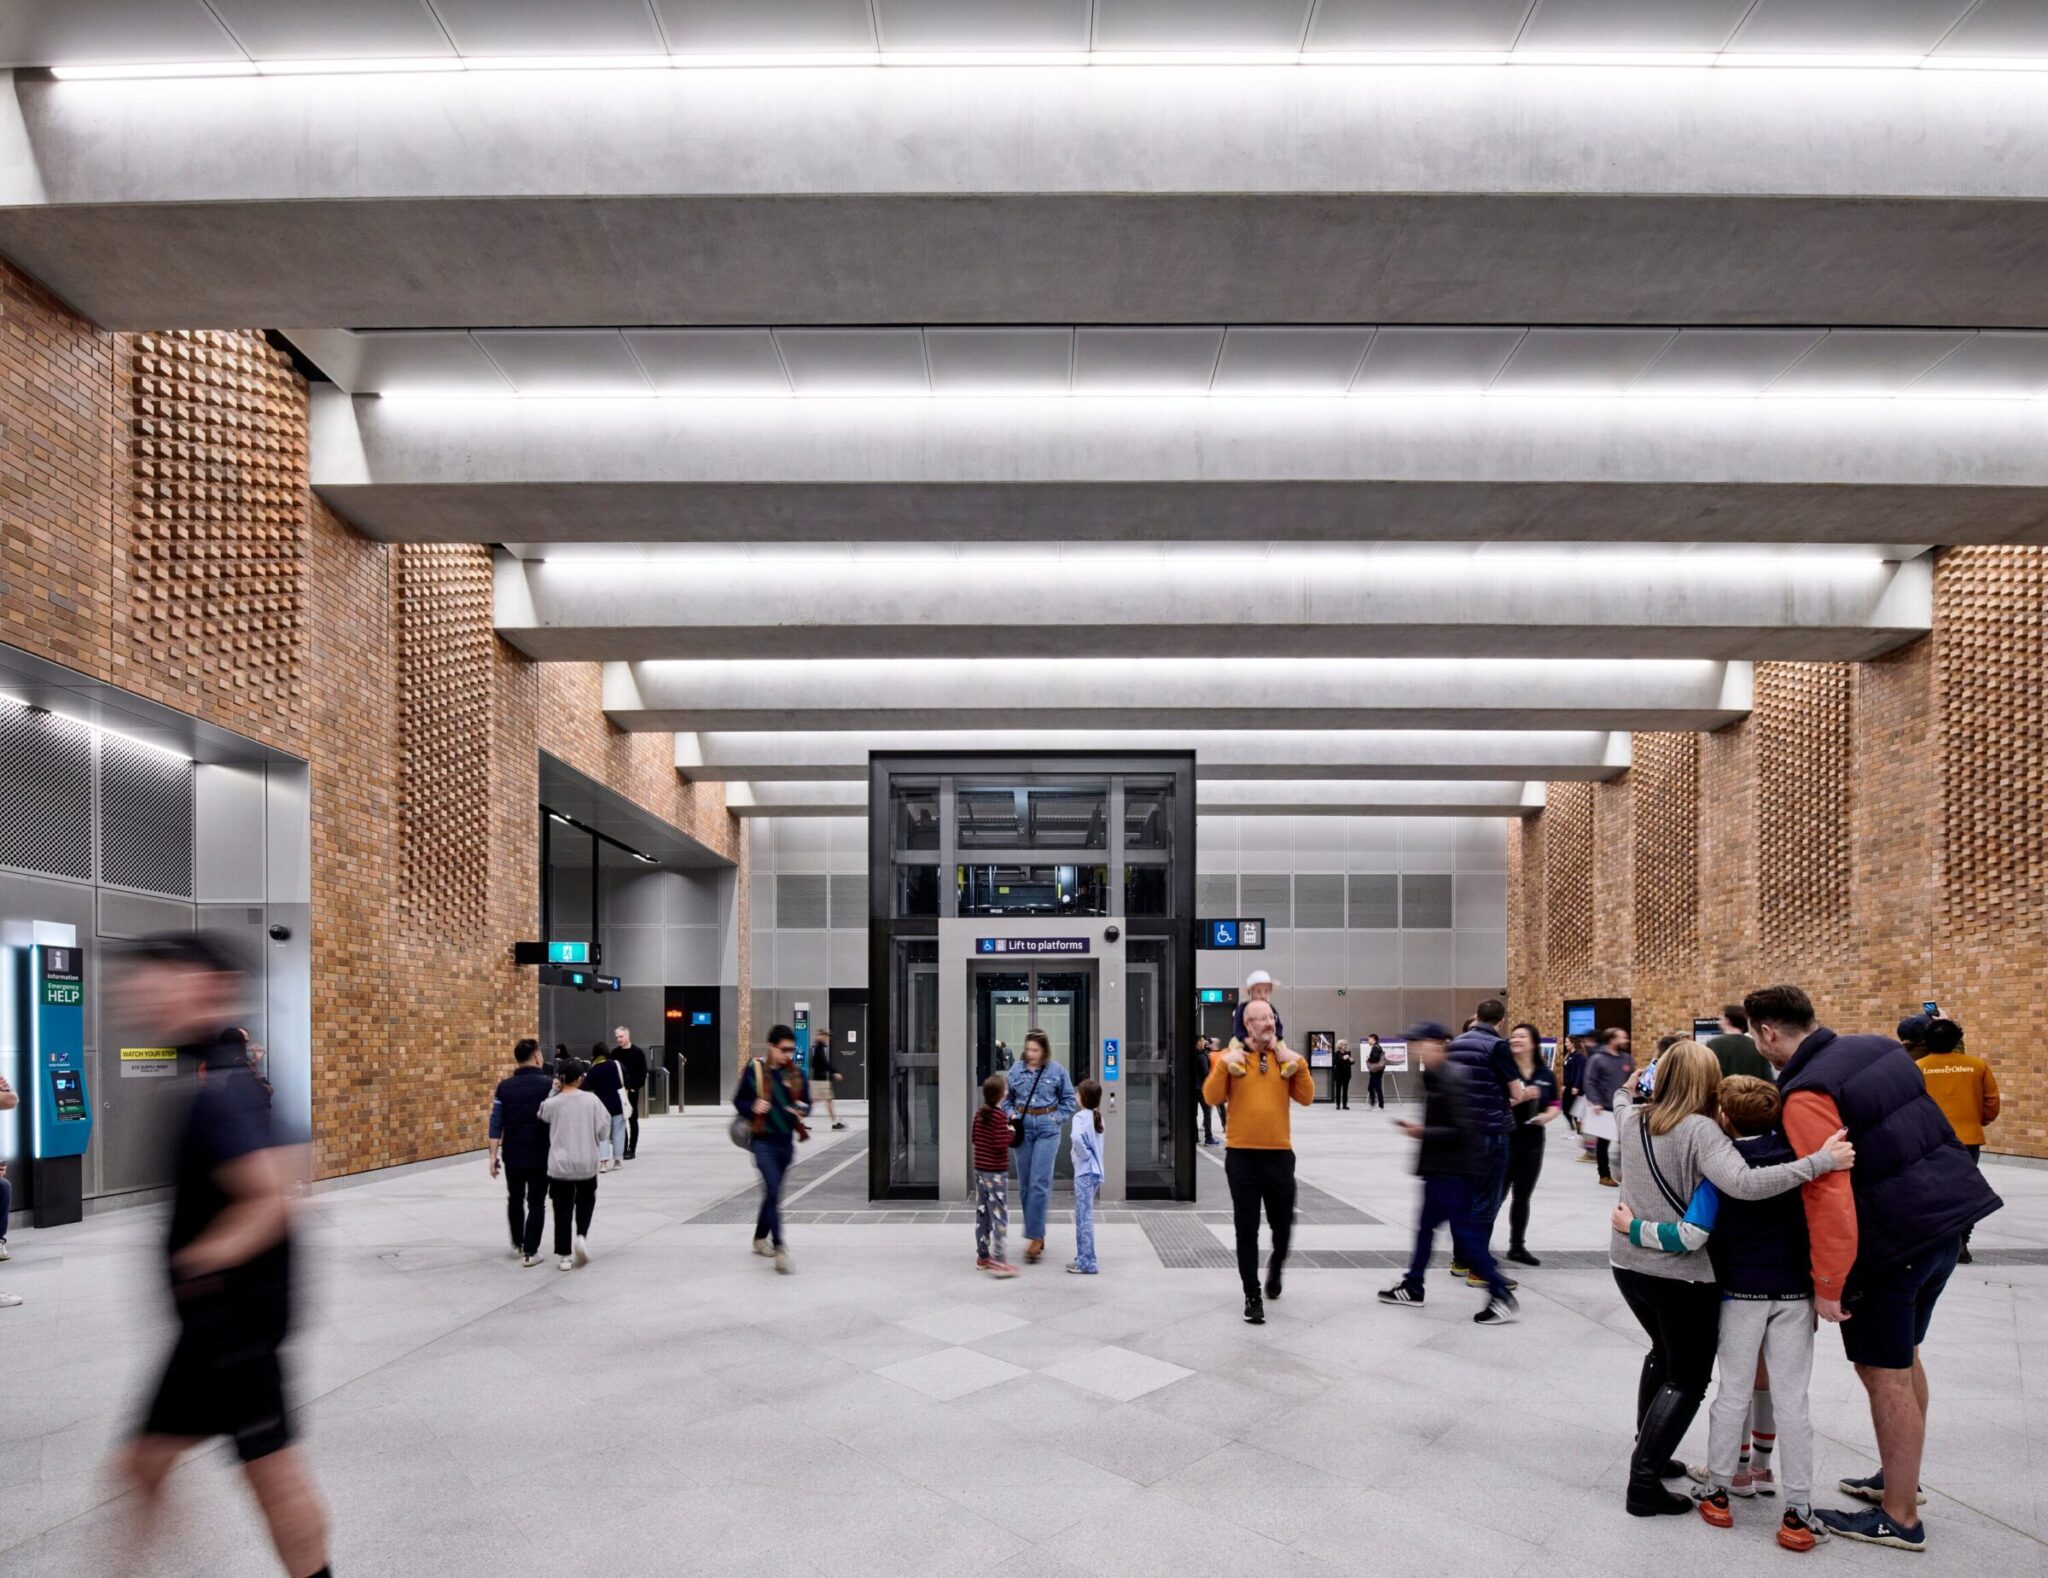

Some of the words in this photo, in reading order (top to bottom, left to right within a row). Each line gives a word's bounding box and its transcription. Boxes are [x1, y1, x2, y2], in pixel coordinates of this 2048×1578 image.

[1008, 940, 1025, 950] Lift
[1026, 942, 1037, 950] to
[1038, 940, 1083, 952] platforms
[47, 973, 79, 981] Information
[48, 982, 79, 991] Emergency
[48, 990, 80, 1003] HELP
[122, 1050, 144, 1058] WATCH
[144, 1050, 161, 1058] YOUR
